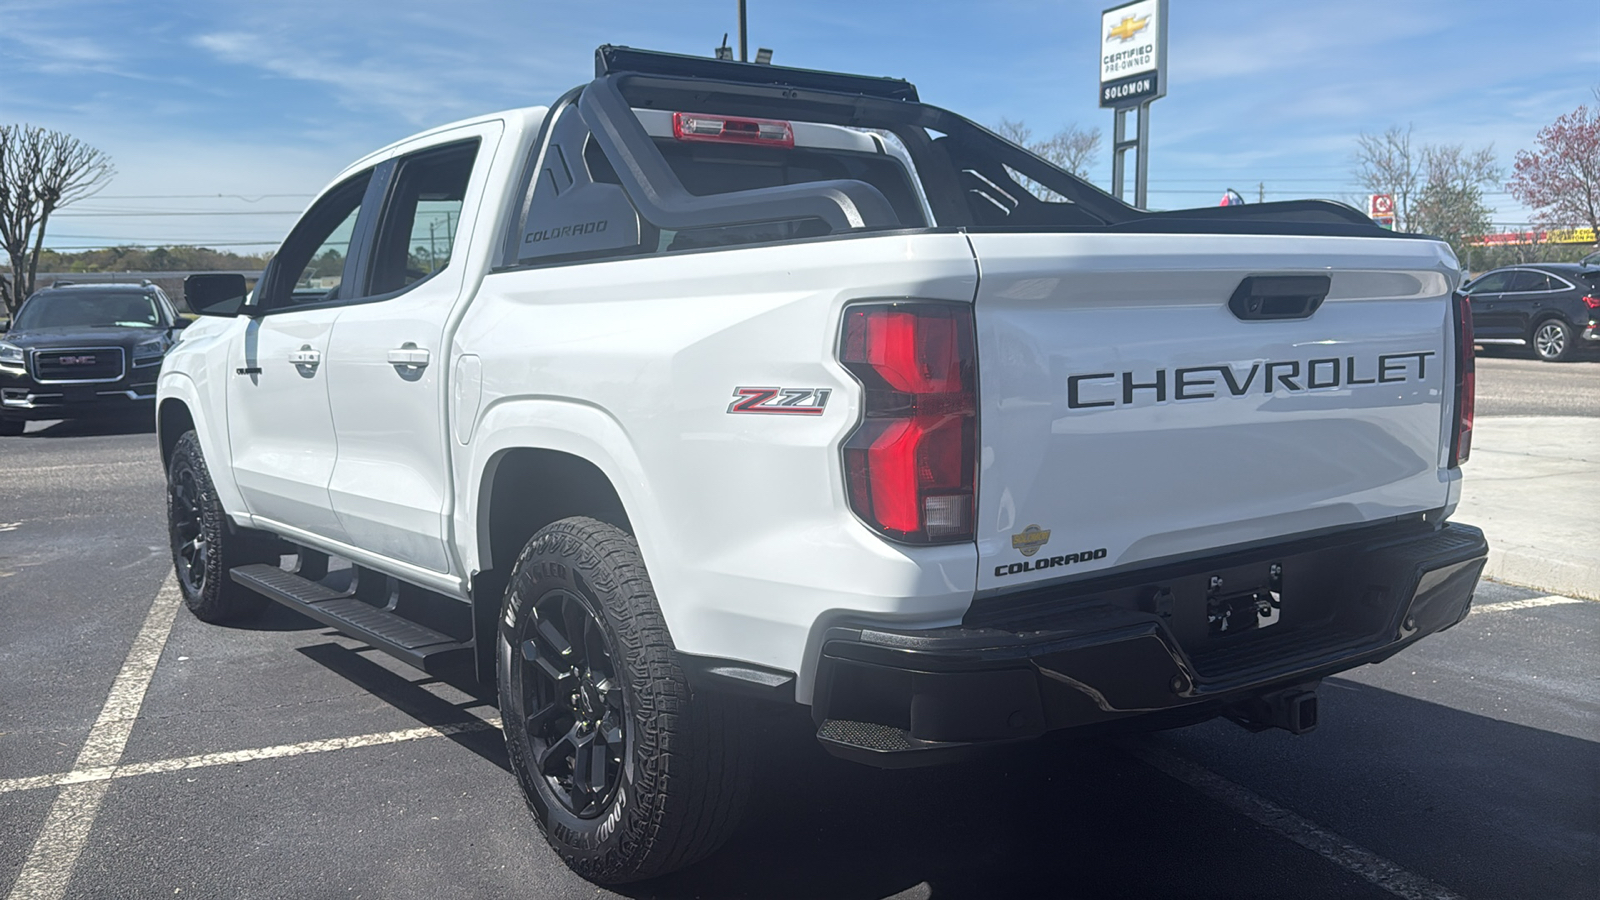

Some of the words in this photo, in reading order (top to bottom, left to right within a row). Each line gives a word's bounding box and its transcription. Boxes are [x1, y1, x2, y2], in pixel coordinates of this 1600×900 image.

[1103, 44, 1153, 65] CERTIFIED
[1105, 55, 1151, 73] PRE-OWNED
[1104, 79, 1150, 100] SOLOMON
[525, 220, 608, 244] COLORADO
[59, 355, 96, 365] GMC
[1067, 350, 1436, 409] CHEVROLET
[726, 386, 832, 416] Z71
[994, 547, 1108, 577] COLORADO
